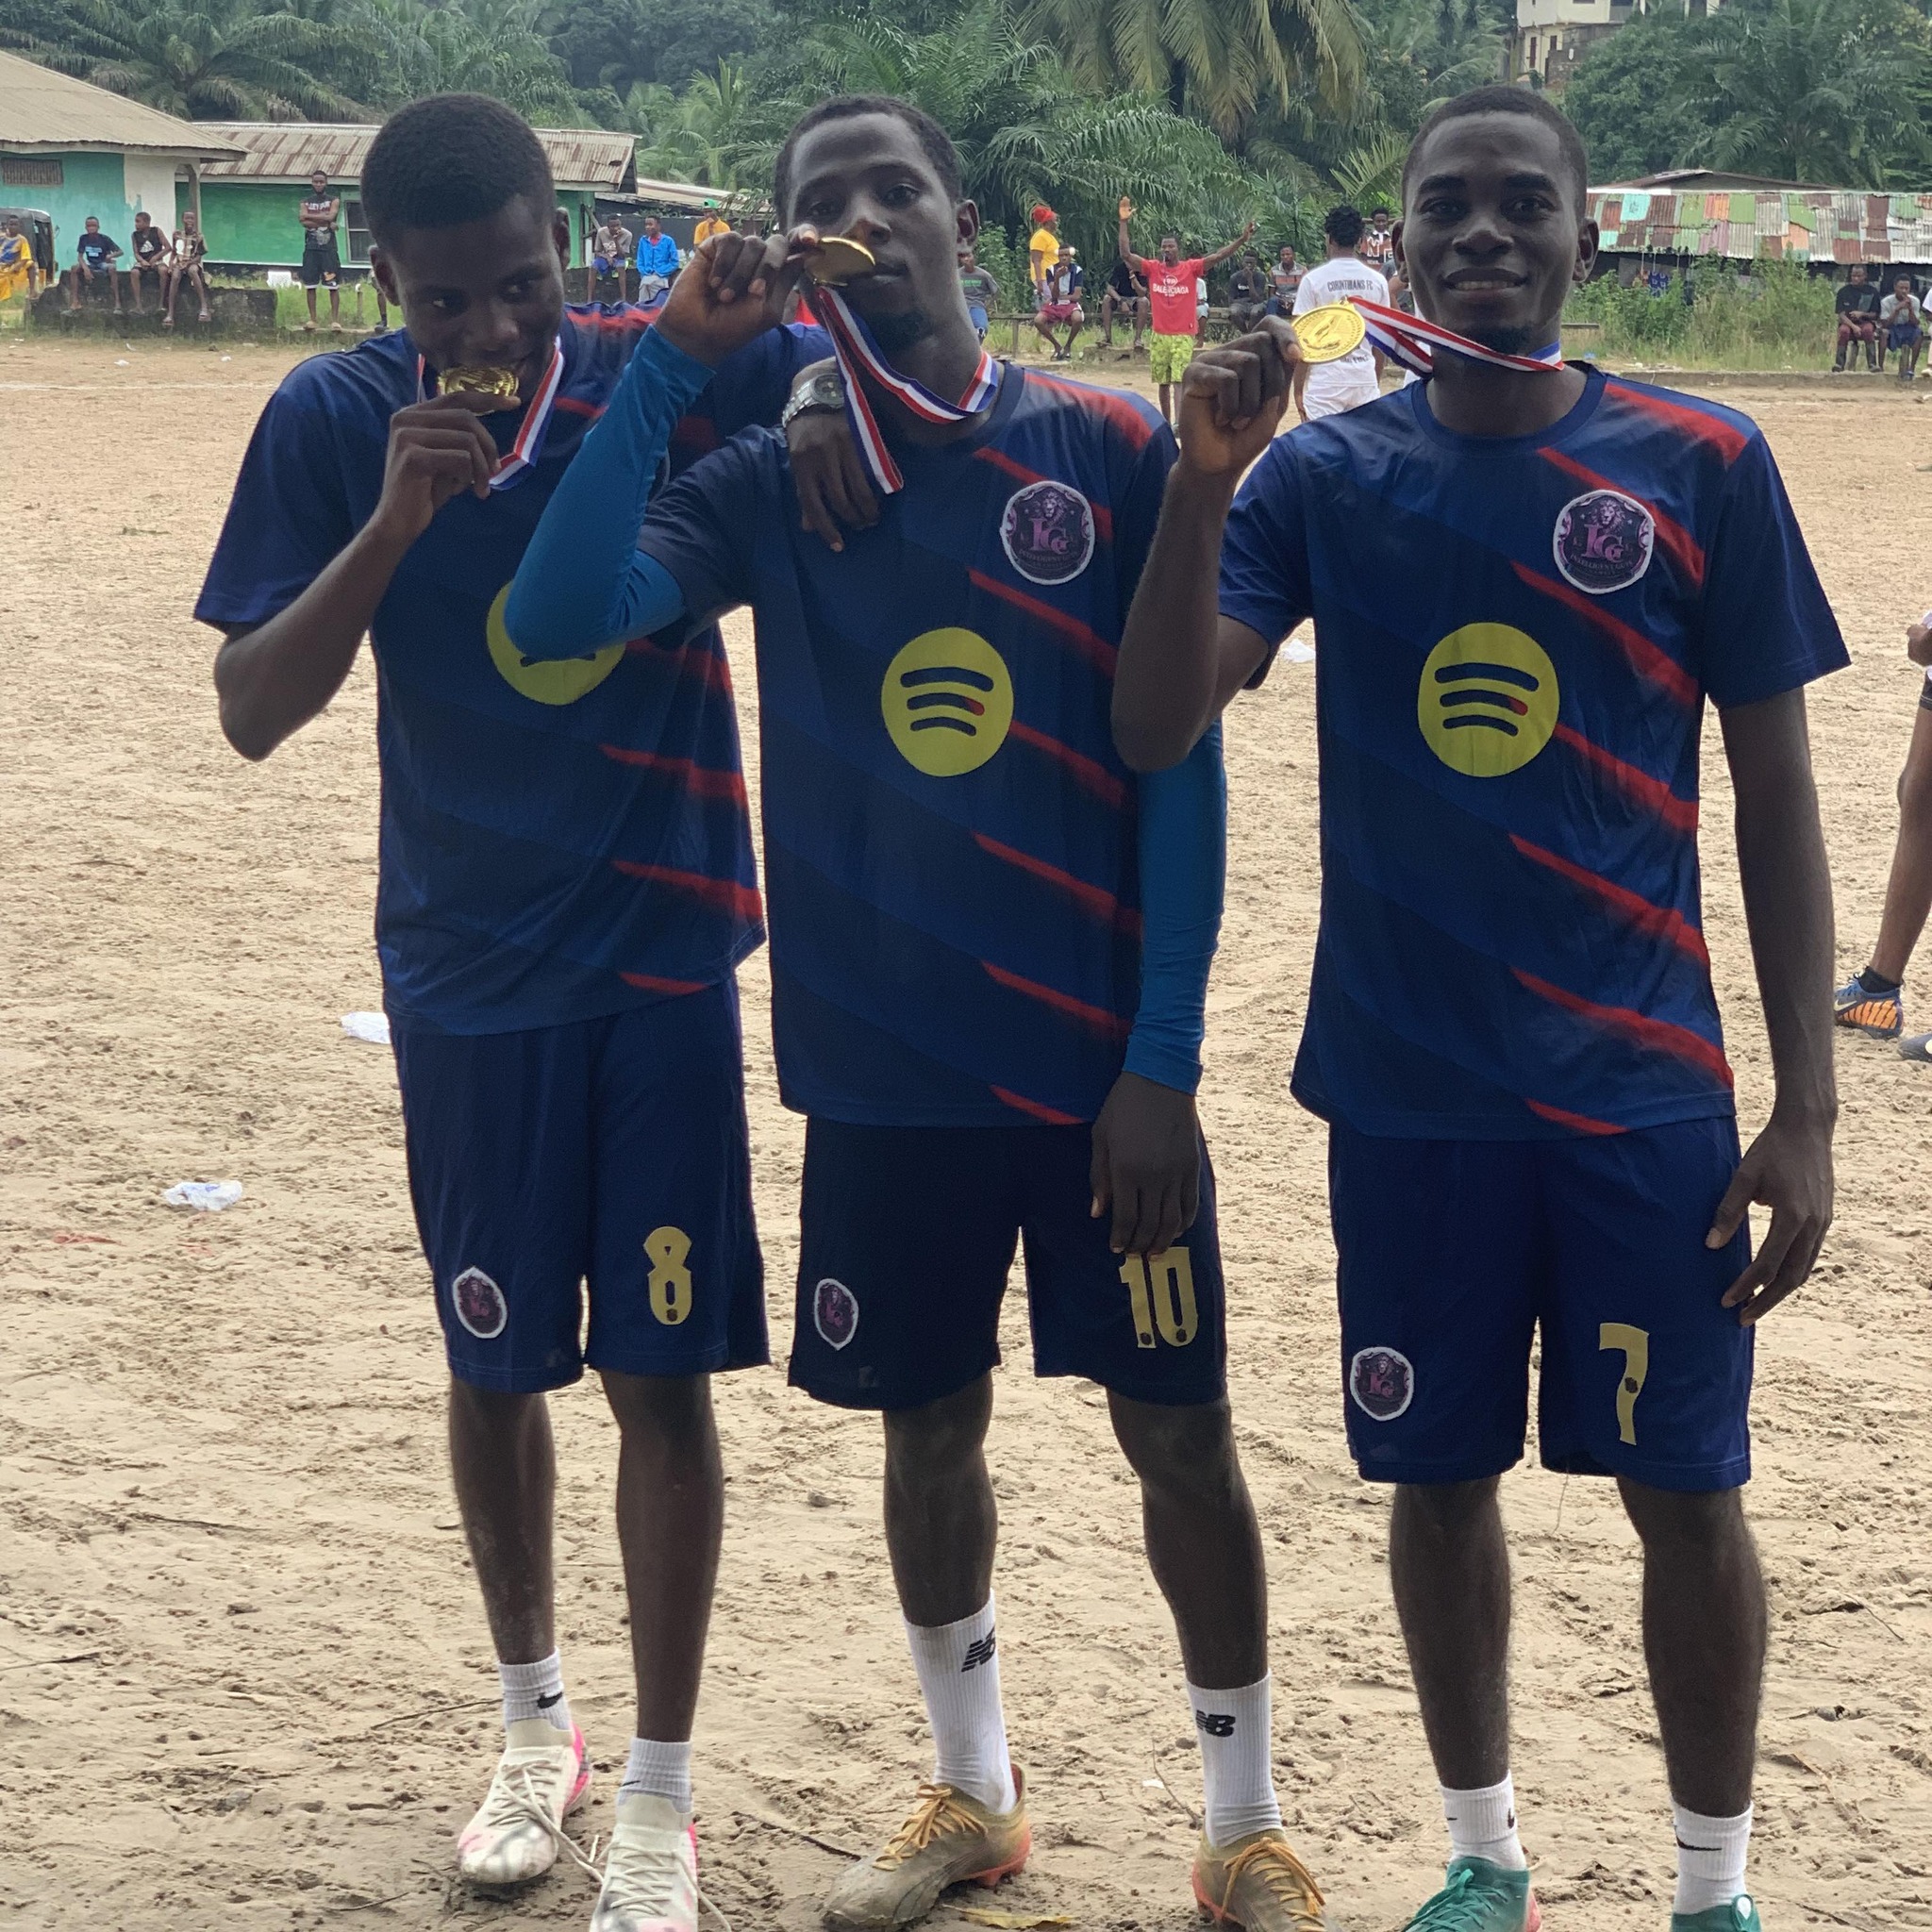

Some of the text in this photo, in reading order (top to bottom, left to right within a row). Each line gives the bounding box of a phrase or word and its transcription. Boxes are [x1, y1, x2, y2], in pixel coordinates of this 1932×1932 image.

[1152, 282, 1190, 294] BALENCIAGA
[643, 1225, 692, 1325] 8
[1119, 1246, 1199, 1349] 10
[1599, 1322, 1650, 1446] 7
[1195, 1709, 1237, 1738] NB
